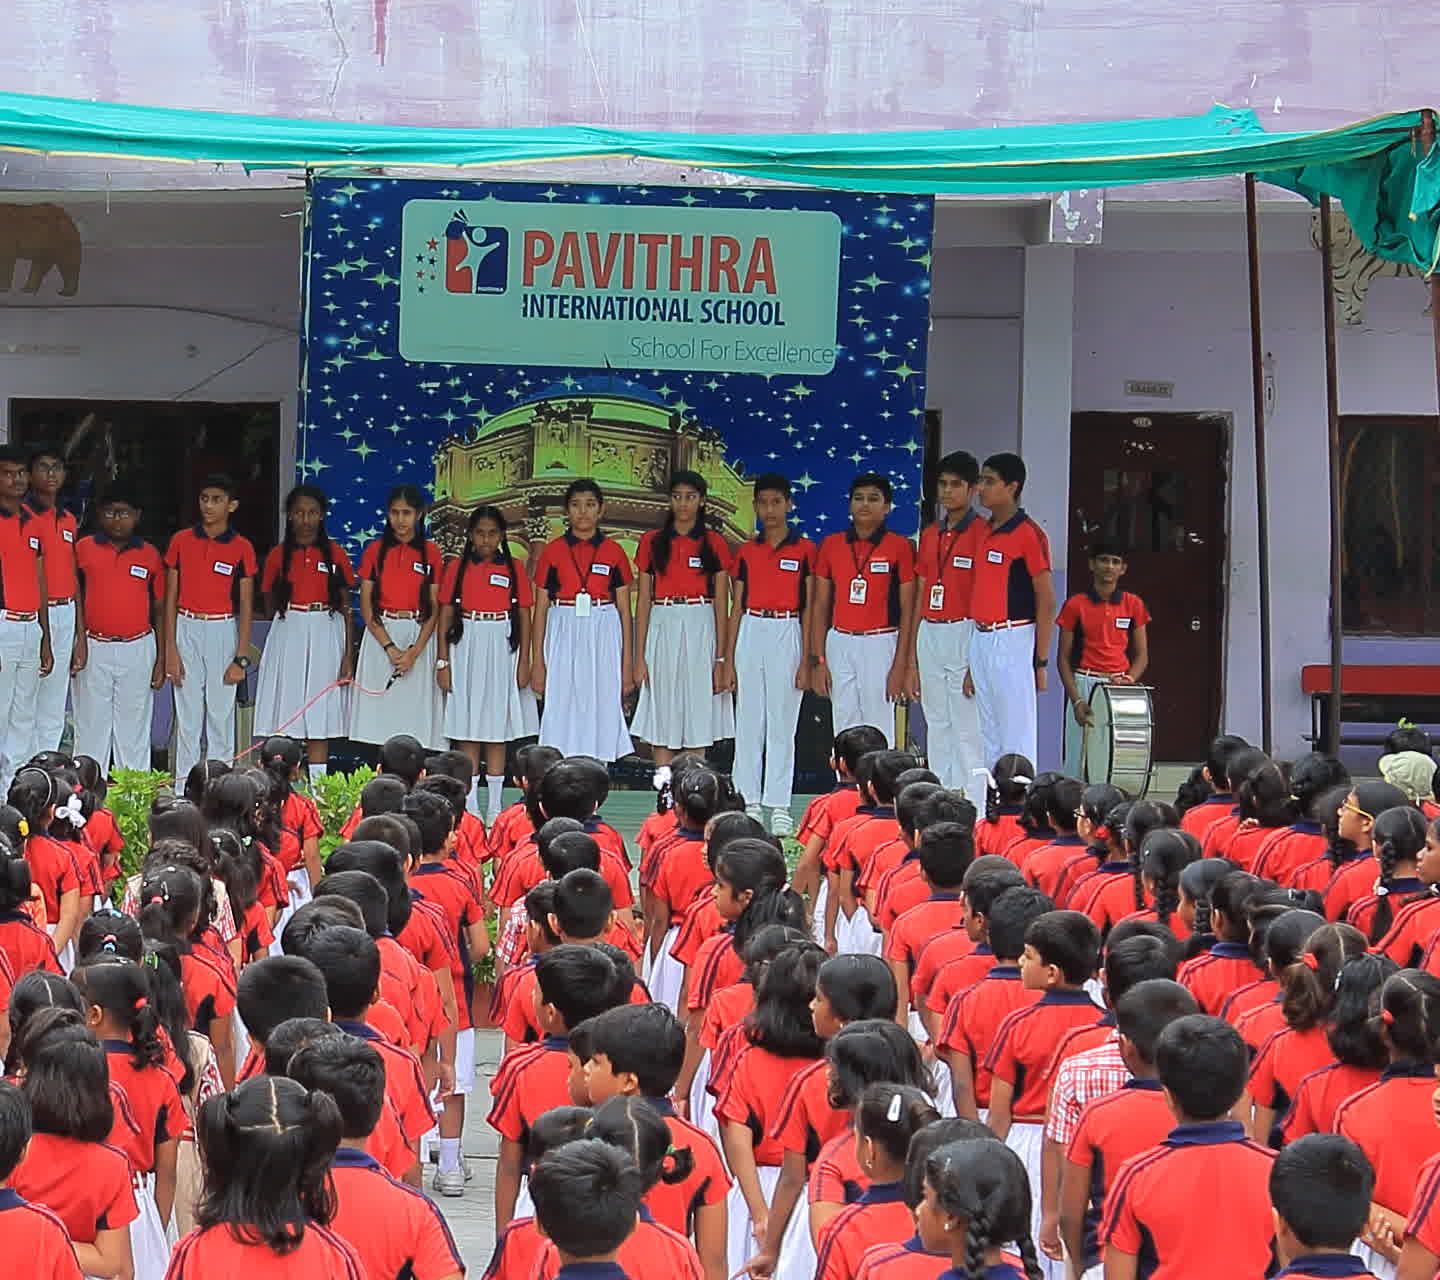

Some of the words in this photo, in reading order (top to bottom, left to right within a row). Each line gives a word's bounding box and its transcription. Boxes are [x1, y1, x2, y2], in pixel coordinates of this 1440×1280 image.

[522, 230, 777, 294] PAVITHRA
[522, 294, 694, 324] INTERNATIONAL
[699, 298, 785, 326] SCHOOL
[630, 336, 695, 360] School
[701, 339, 730, 361] For
[735, 340, 835, 365] Excellence
